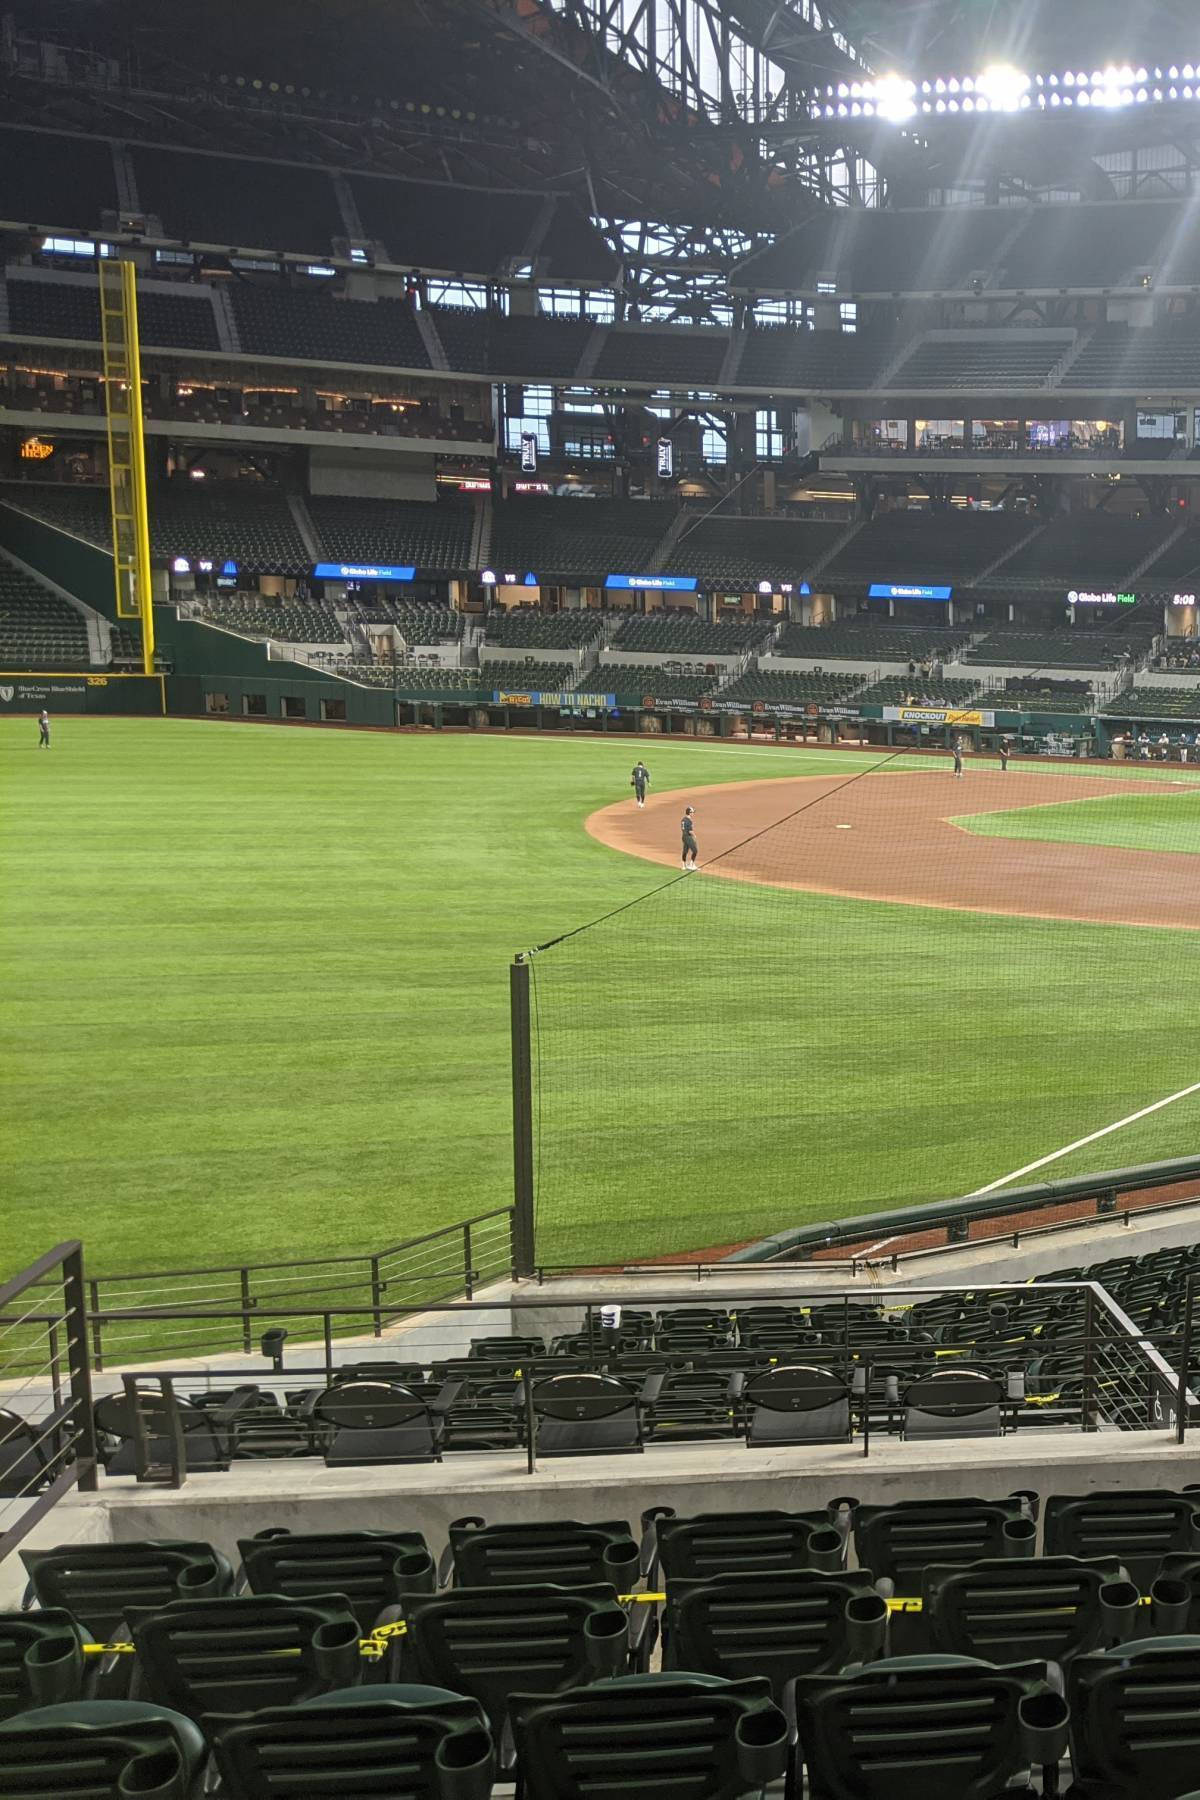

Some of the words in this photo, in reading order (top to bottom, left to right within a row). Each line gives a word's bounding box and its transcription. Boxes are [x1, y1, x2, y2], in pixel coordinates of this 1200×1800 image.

[522, 439, 530, 464] TRULY
[658, 444, 666, 470] TRULY
[200, 562, 212, 571] VS
[505, 574, 516, 582] VS
[781, 584, 792, 592] VS
[1078, 592, 1101, 603] Globe
[87, 677, 107, 686] 326
[539, 693, 561, 705] HOW
[564, 693, 576, 706] TO
[577, 694, 607, 706] NACHO
[904, 711, 945, 720] KNOCKOUT
